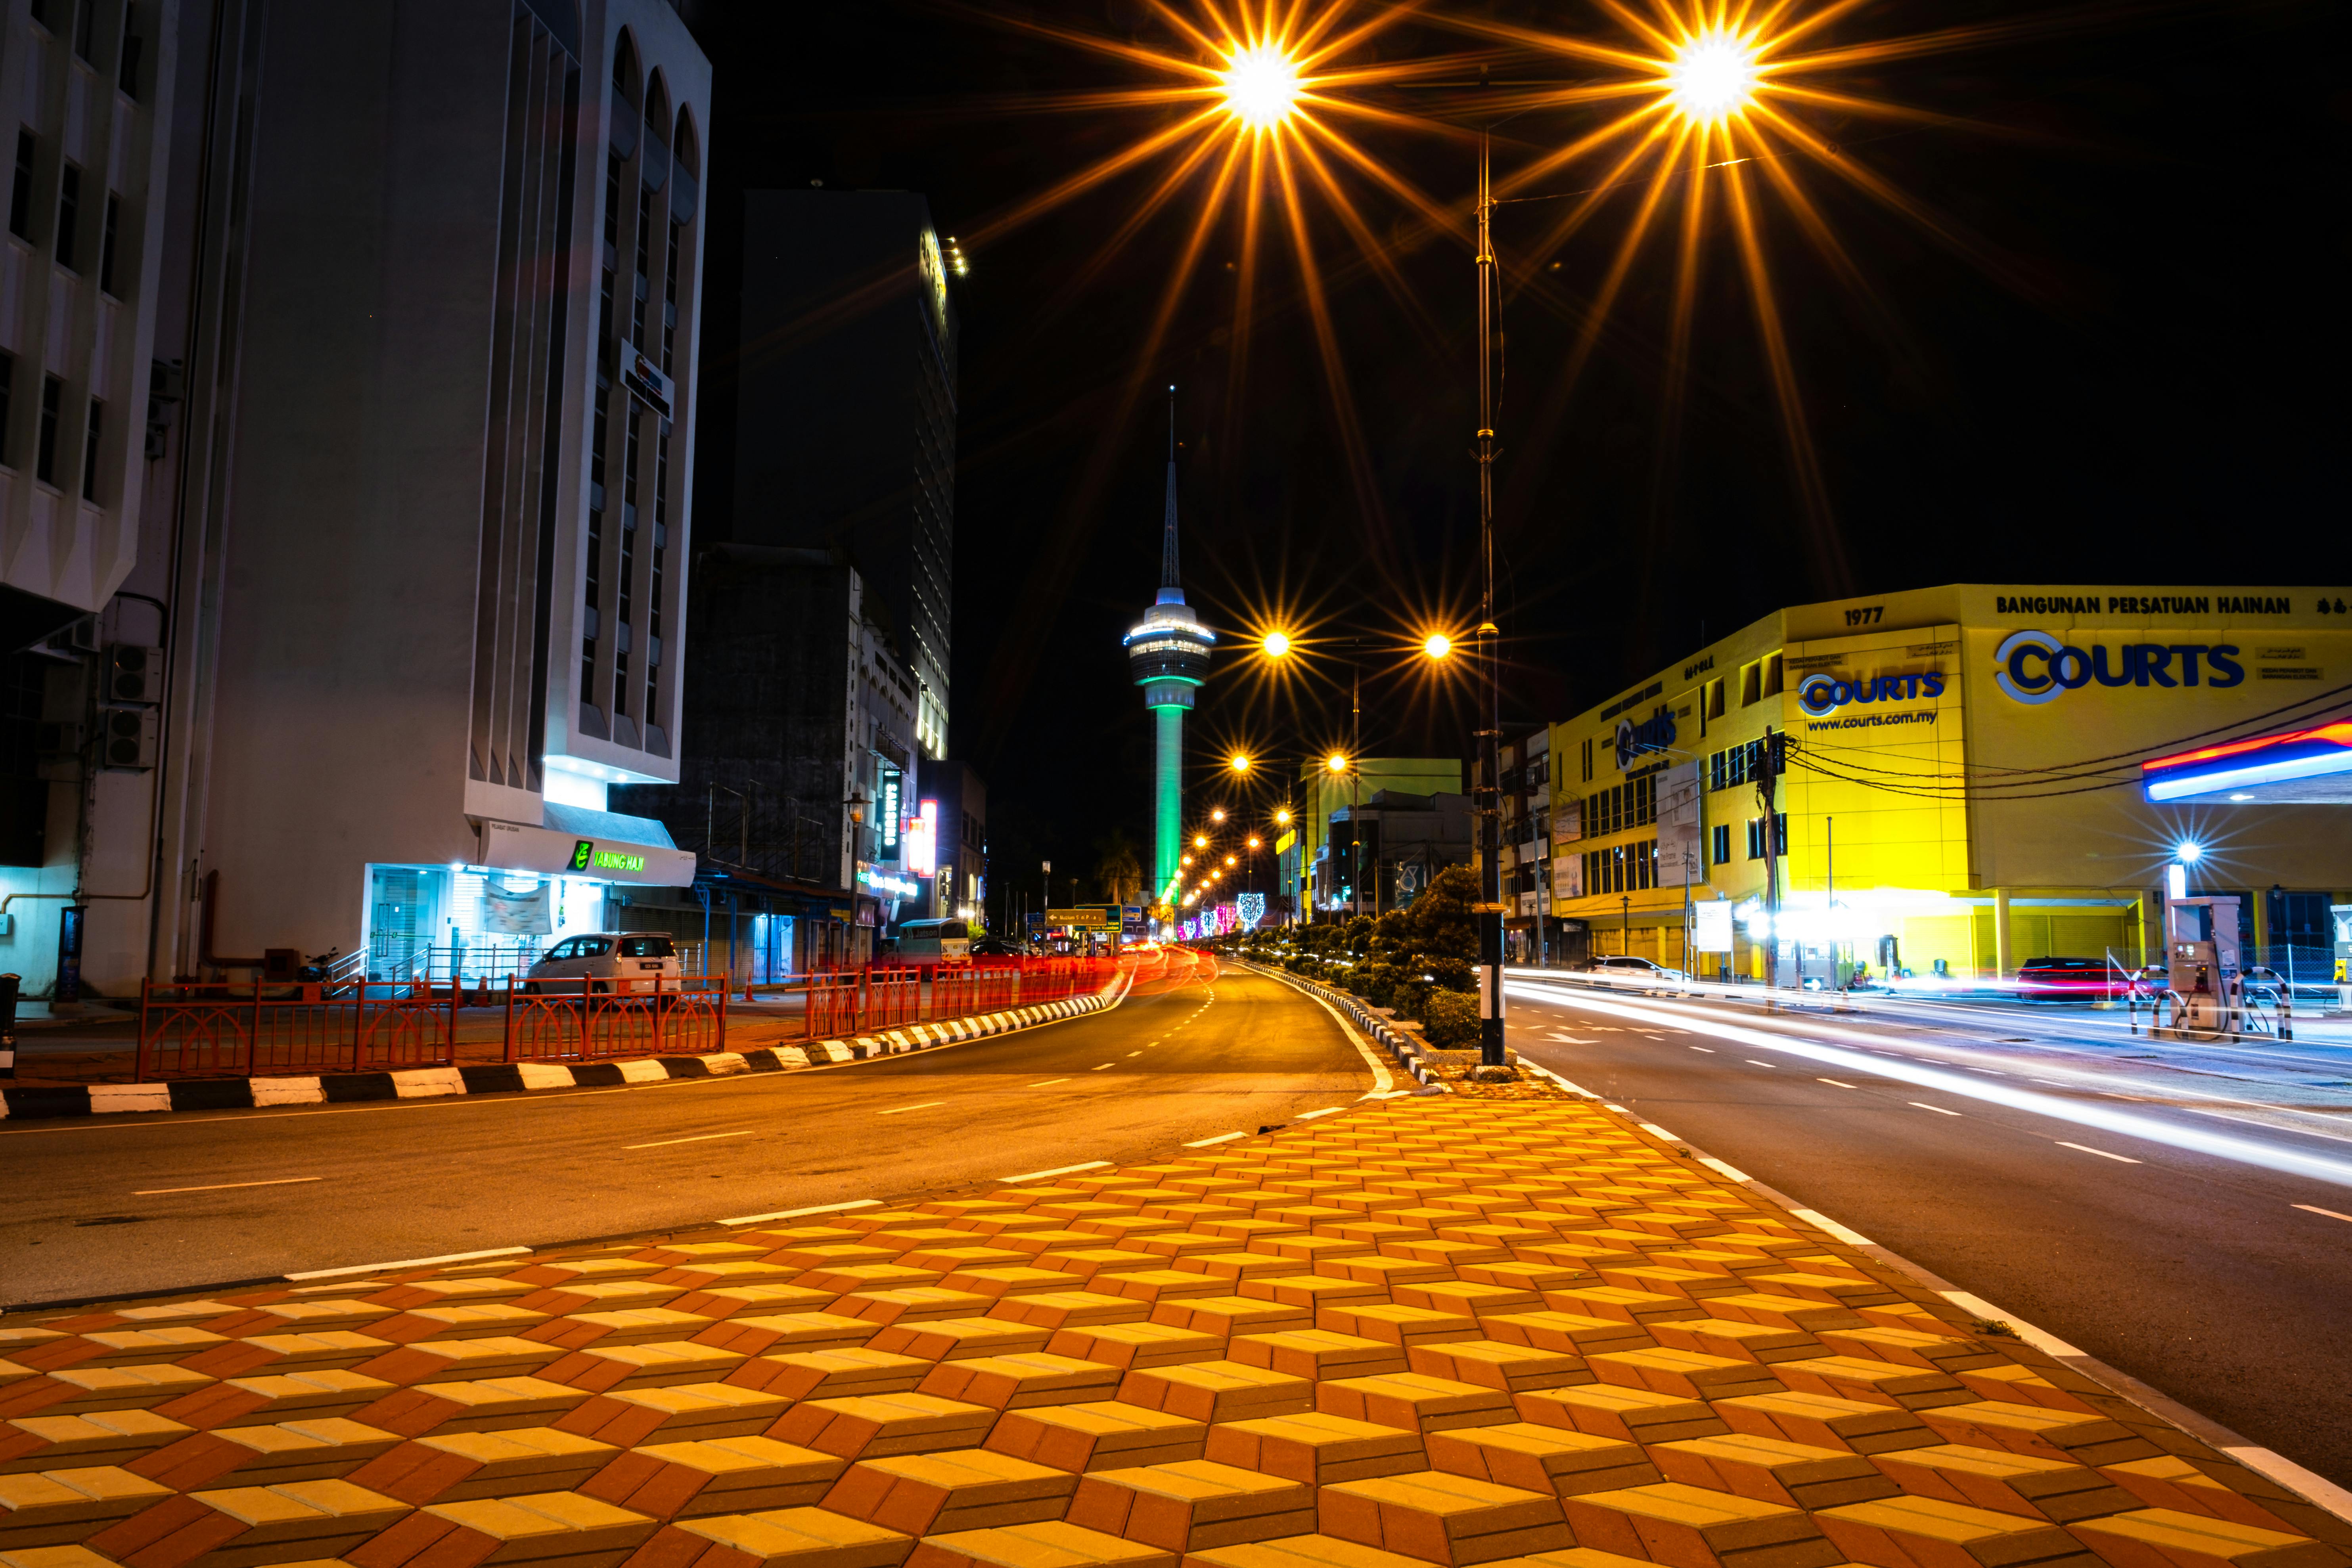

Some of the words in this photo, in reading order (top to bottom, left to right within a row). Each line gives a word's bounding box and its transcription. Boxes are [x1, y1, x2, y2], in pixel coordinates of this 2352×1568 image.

[1997, 596, 2100, 614] BANGUNAN
[2109, 597, 2209, 614] PERSATUAN
[2218, 597, 2290, 614] HAINAN
[1844, 606, 1883, 626] 1977
[2009, 645, 2245, 689] COURTS
[1807, 672, 1944, 707] COURTS
[1808, 711, 1938, 731] www.courts.com.my
[885, 783, 898, 845] SAMSUNG
[594, 851, 626, 869] TABUNG
[625, 855, 645, 872] HAJI
[916, 929, 937, 938] Jatson
